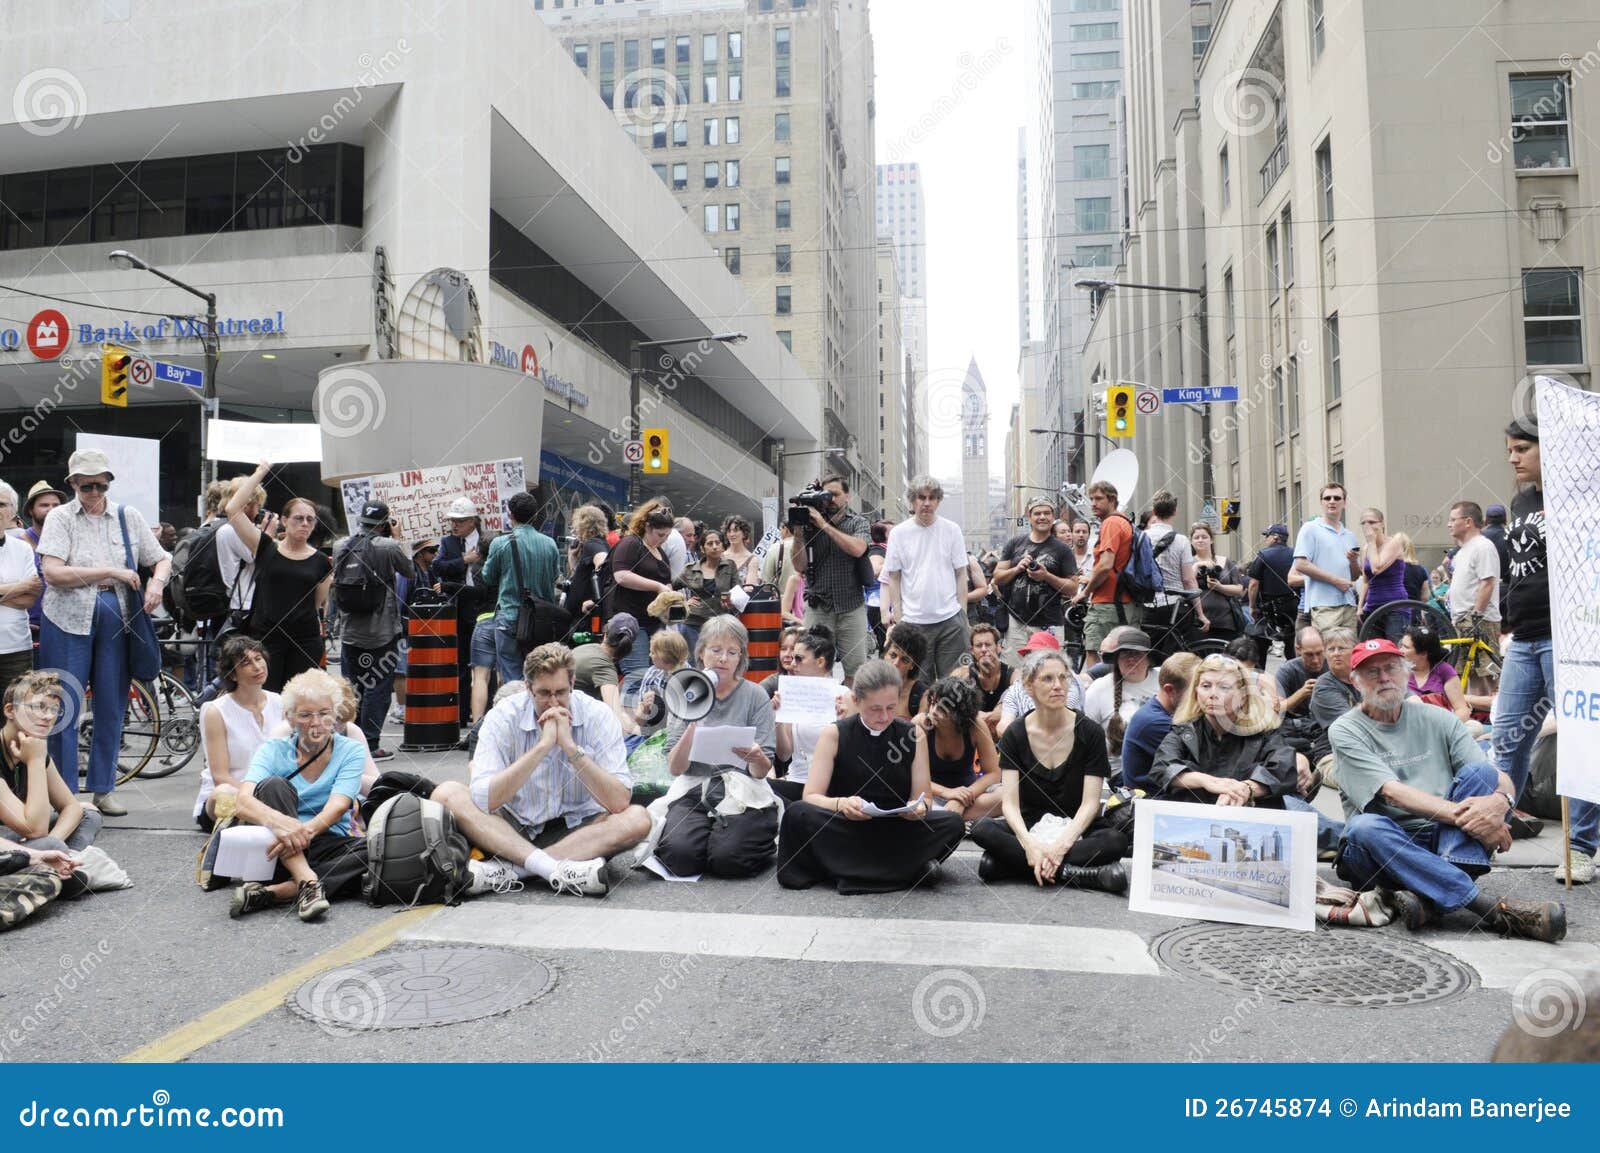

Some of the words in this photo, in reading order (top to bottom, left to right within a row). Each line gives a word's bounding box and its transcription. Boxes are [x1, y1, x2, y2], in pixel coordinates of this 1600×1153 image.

[78, 320, 137, 344] Bank
[143, 318, 171, 338] of
[493, 341, 519, 369] BMO
[167, 366, 185, 382] Bay
[1178, 389, 1202, 402] King
[1211, 387, 1222, 399] W
[1217, 868, 1247, 879] Fence
[1249, 870, 1265, 882] Me
[1266, 871, 1287, 886] Out
[1153, 882, 1215, 899] DEMOCRACY
